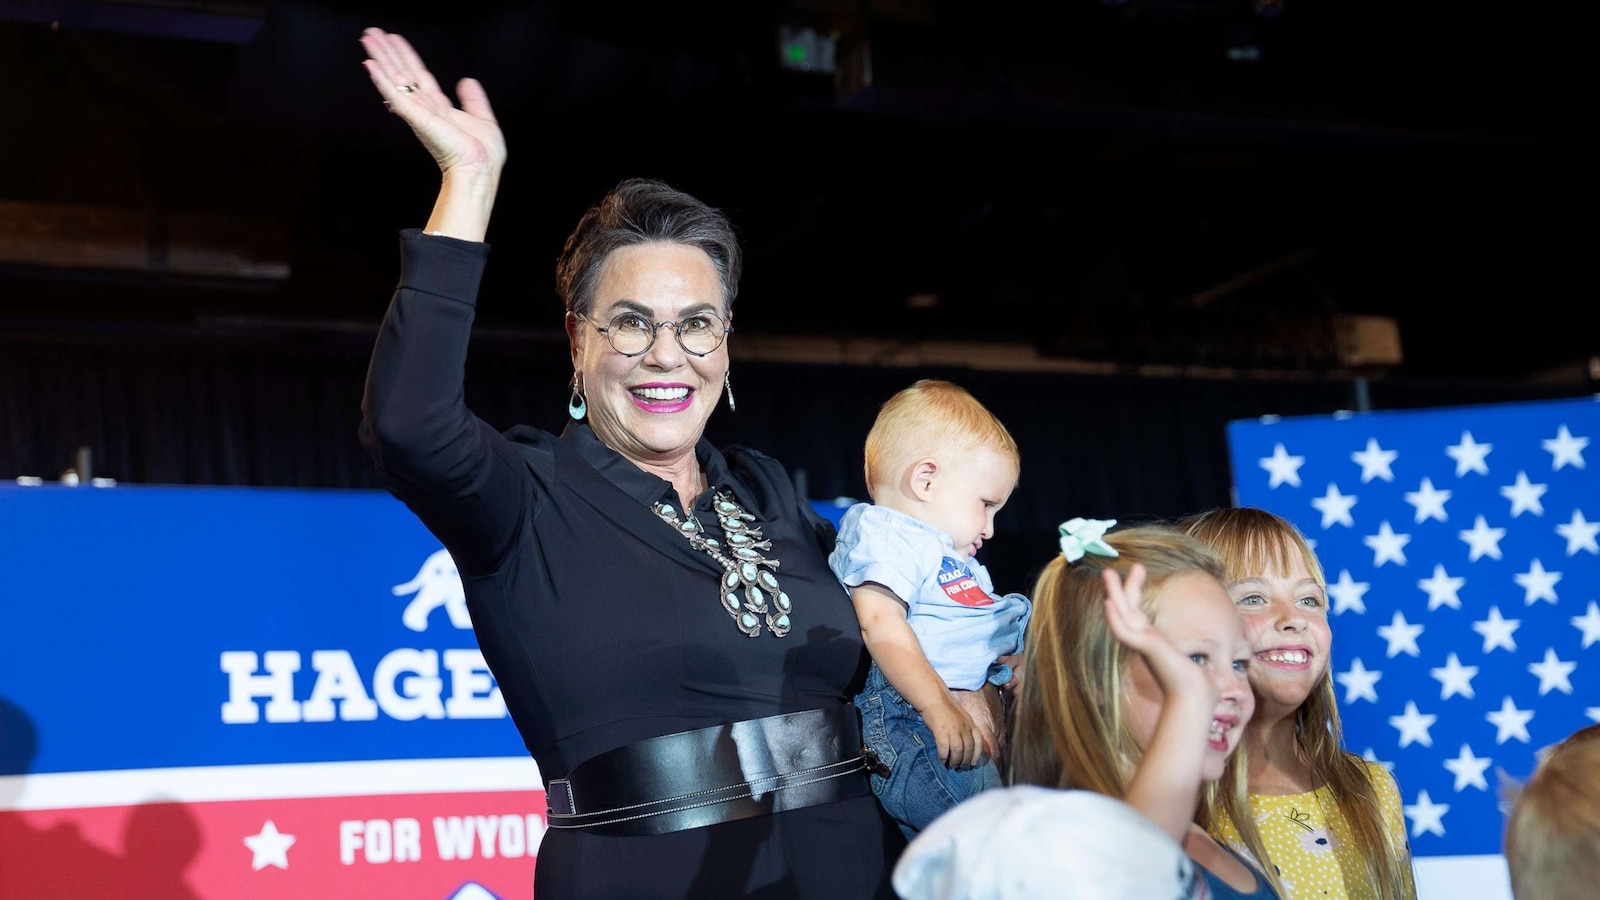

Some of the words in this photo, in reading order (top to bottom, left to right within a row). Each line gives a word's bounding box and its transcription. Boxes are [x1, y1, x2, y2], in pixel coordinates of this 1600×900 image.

[945, 584, 962, 596] FOR
[220, 648, 507, 724] HAGE
[339, 818, 422, 866] FOR
